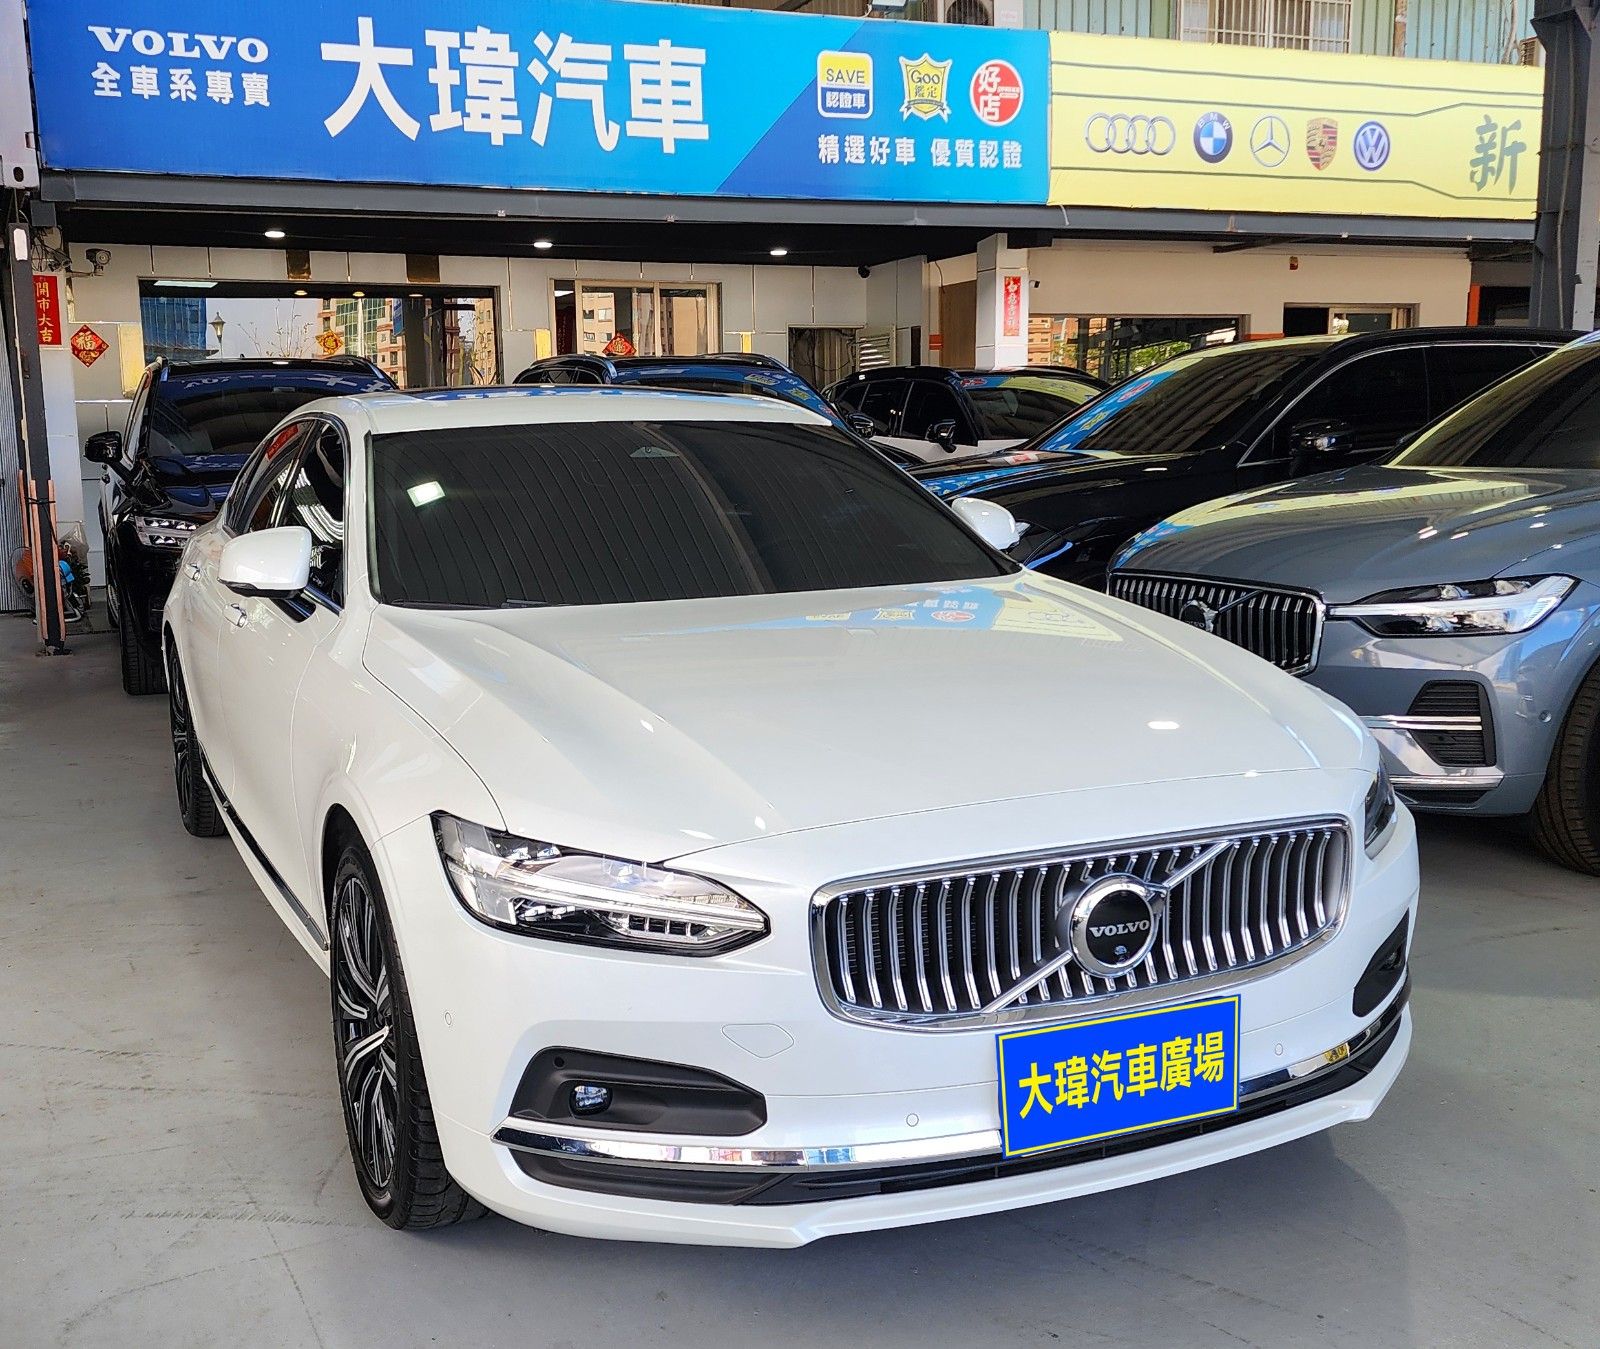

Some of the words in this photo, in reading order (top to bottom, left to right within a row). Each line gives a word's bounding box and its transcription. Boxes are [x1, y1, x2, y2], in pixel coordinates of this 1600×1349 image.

[87, 26, 270, 63] VOLVO
[91, 61, 271, 108] 全車系專賣
[319, 16, 710, 154] 大瑋汽車
[826, 68, 865, 84] SAVE
[911, 69, 940, 85] Goo
[978, 66, 1001, 121] 好店
[825, 91, 866, 109] 認證車
[1198, 112, 1231, 130] BMW
[818, 134, 916, 165] 精選好車
[930, 138, 1023, 169] 優質認證
[1469, 114, 1528, 195] 新
[36, 281, 54, 343] 開市大吉
[1088, 919, 1150, 938] VOLVO
